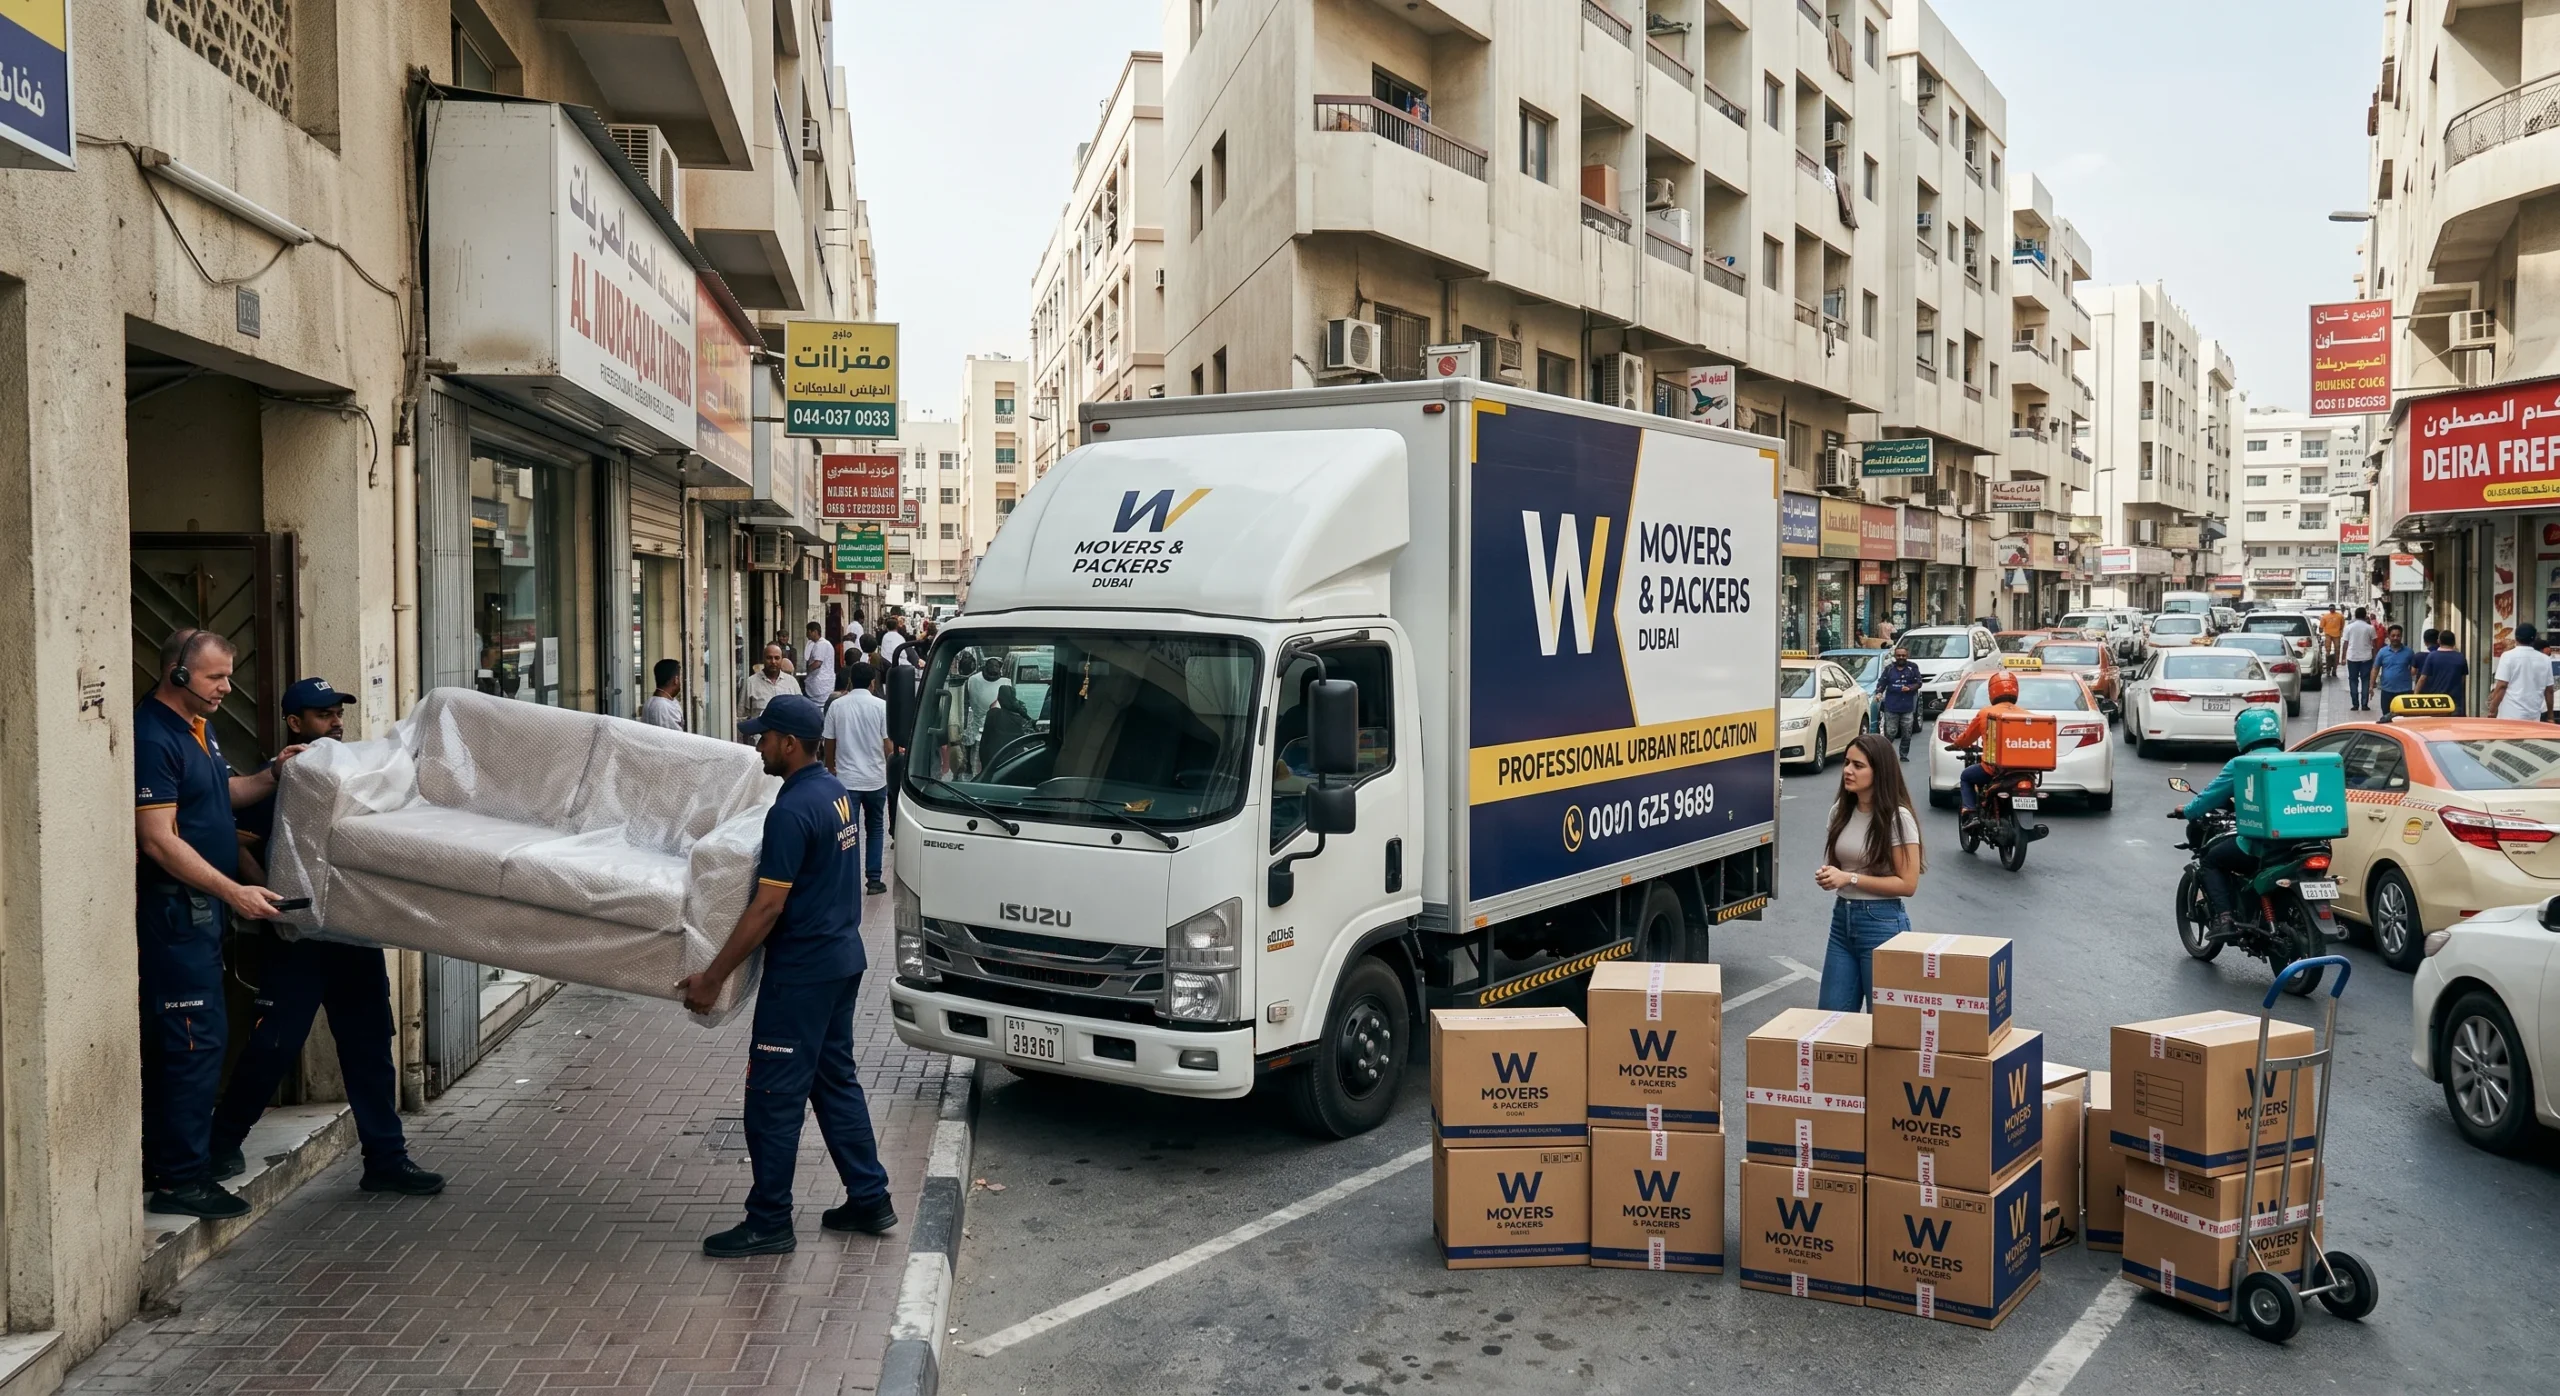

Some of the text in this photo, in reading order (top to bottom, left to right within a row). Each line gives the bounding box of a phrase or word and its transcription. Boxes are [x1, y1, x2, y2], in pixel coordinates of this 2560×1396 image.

[570, 252, 591, 339] AL
[2423, 443, 2491, 481] DEIRA
[1074, 540, 1184, 555] MOVERS &
[1639, 521, 1732, 567] MOVERS
[1072, 558, 1173, 574] PACKERS
[1092, 577, 1133, 588] DUBAI
[1521, 510, 1611, 656] W
[1638, 574, 1750, 614] & PACKERS
[1638, 627, 1680, 651] DUBAI
[1498, 721, 1757, 786] PROFESSIONAL URBAN RELOCATION
[2005, 738, 2051, 749] talabat
[1674, 783, 1714, 821] 9689
[2283, 803, 2333, 815] deliveroo
[1000, 902, 1071, 928] ISUZU
[1013, 1034, 1054, 1058] 39360
[1629, 1028, 1677, 1062] W
[1492, 1052, 1538, 1083] W
[1619, 1064, 1688, 1079] MOVERS
[1481, 1087, 1549, 1100] MOVERS
[1638, 1079, 1677, 1088] PACKERS
[2008, 1063, 2027, 1109] W
[1777, 1093, 1812, 1105] FRAGILE
[1903, 1081, 1951, 1119] W
[1892, 1117, 1961, 1139] MOVERS
[1903, 1134, 1950, 1147] & PACKERS
[1497, 1171, 1543, 1203] W
[1634, 1169, 1680, 1202] W
[1487, 1206, 1554, 1220] MOVERS
[1623, 1205, 1691, 1220] MOVERS
[1776, 1197, 1823, 1232] W
[2009, 1191, 2028, 1240] W
[1505, 1221, 1544, 1229] PACKERS
[1904, 1214, 1952, 1252] W
[1765, 1231, 1834, 1252] MOVERS
[2251, 1231, 2298, 1251] MOVERS
[1893, 1249, 1963, 1272] MOVERS
